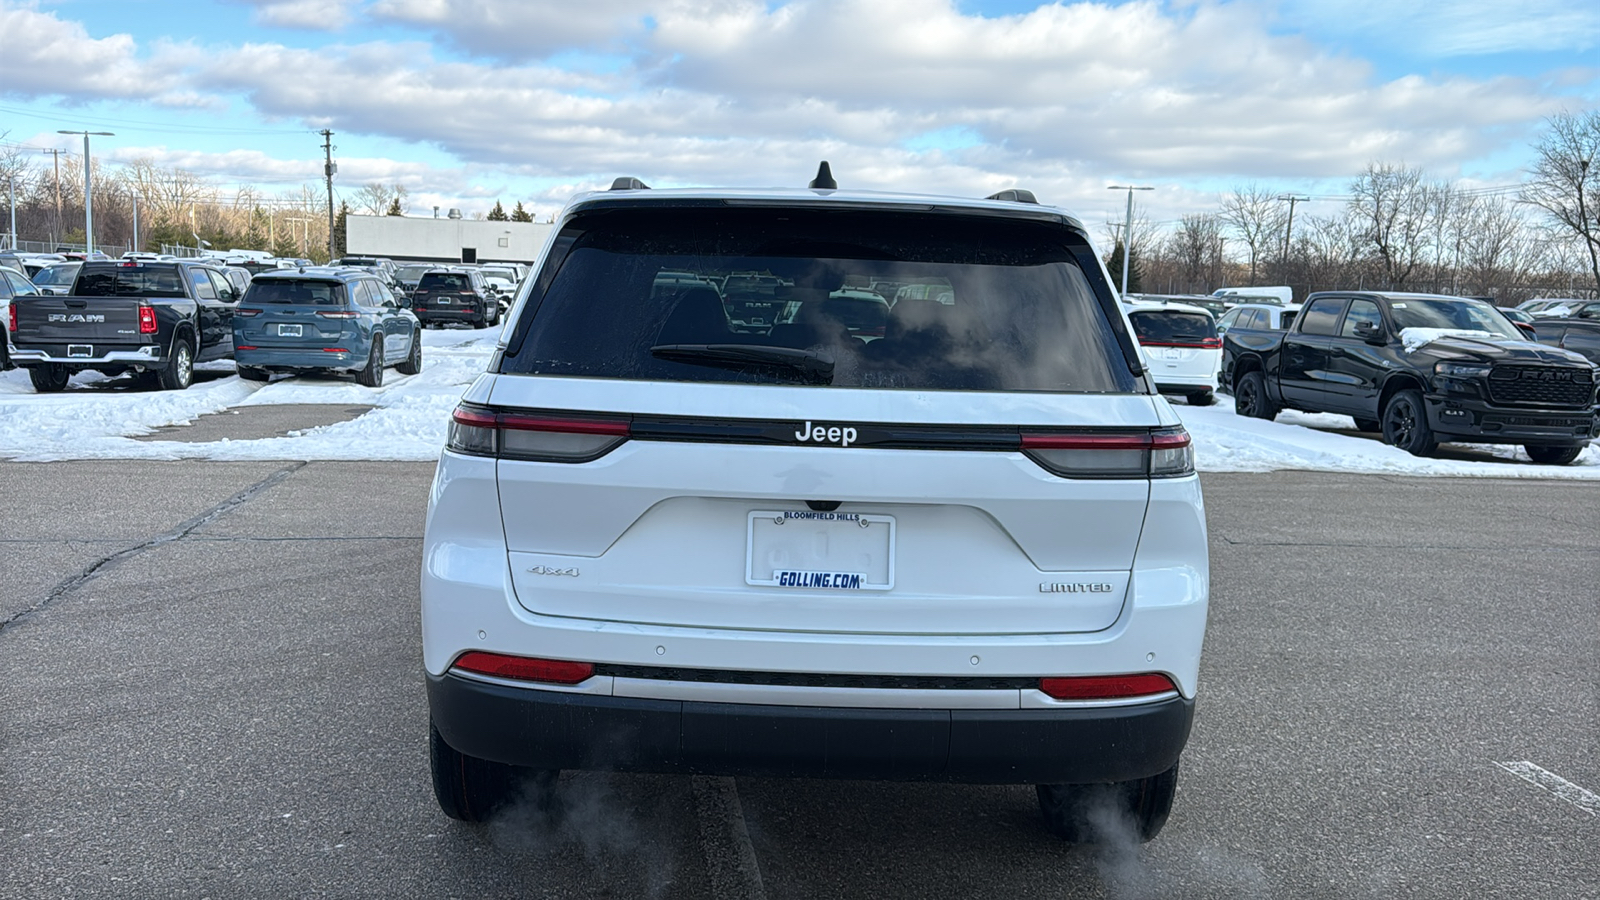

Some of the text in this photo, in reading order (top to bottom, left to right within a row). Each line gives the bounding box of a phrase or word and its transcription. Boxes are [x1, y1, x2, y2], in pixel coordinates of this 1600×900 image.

[48, 314, 105, 322] RAM
[1521, 370, 1572, 380] RAM
[795, 421, 857, 447] Jeep
[784, 511, 860, 522] BLOOMFIELD HILLS
[526, 564, 580, 577] 4x4
[779, 571, 860, 589] GOLLING.COM
[1039, 582, 1113, 593] LIMITED
